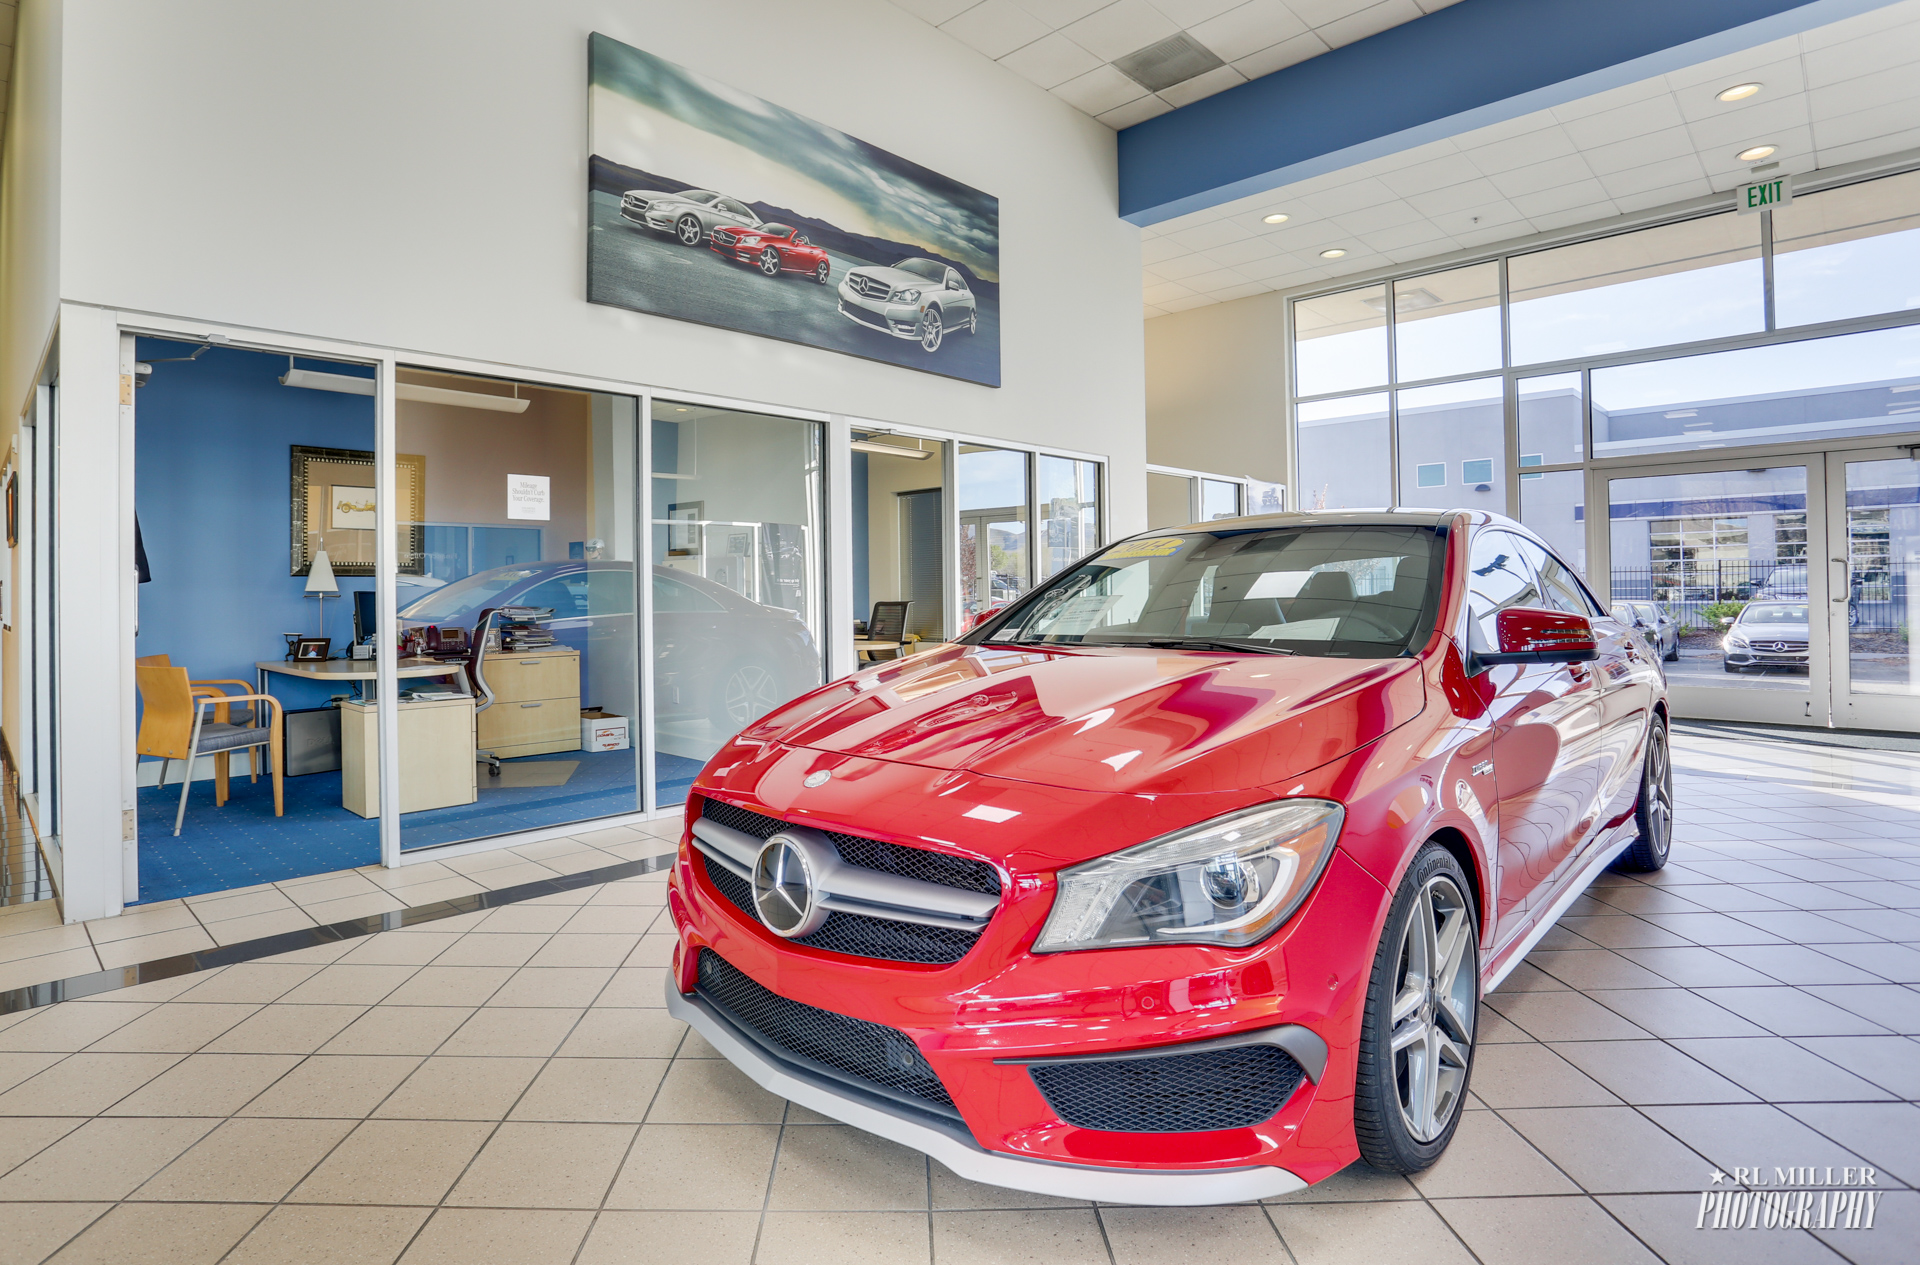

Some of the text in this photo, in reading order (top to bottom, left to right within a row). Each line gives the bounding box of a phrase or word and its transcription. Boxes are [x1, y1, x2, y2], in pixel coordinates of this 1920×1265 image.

[1748, 181, 1783, 208] EXIT
[512, 488, 533, 496] Shouldn't
[1417, 855, 1451, 887] Continental
